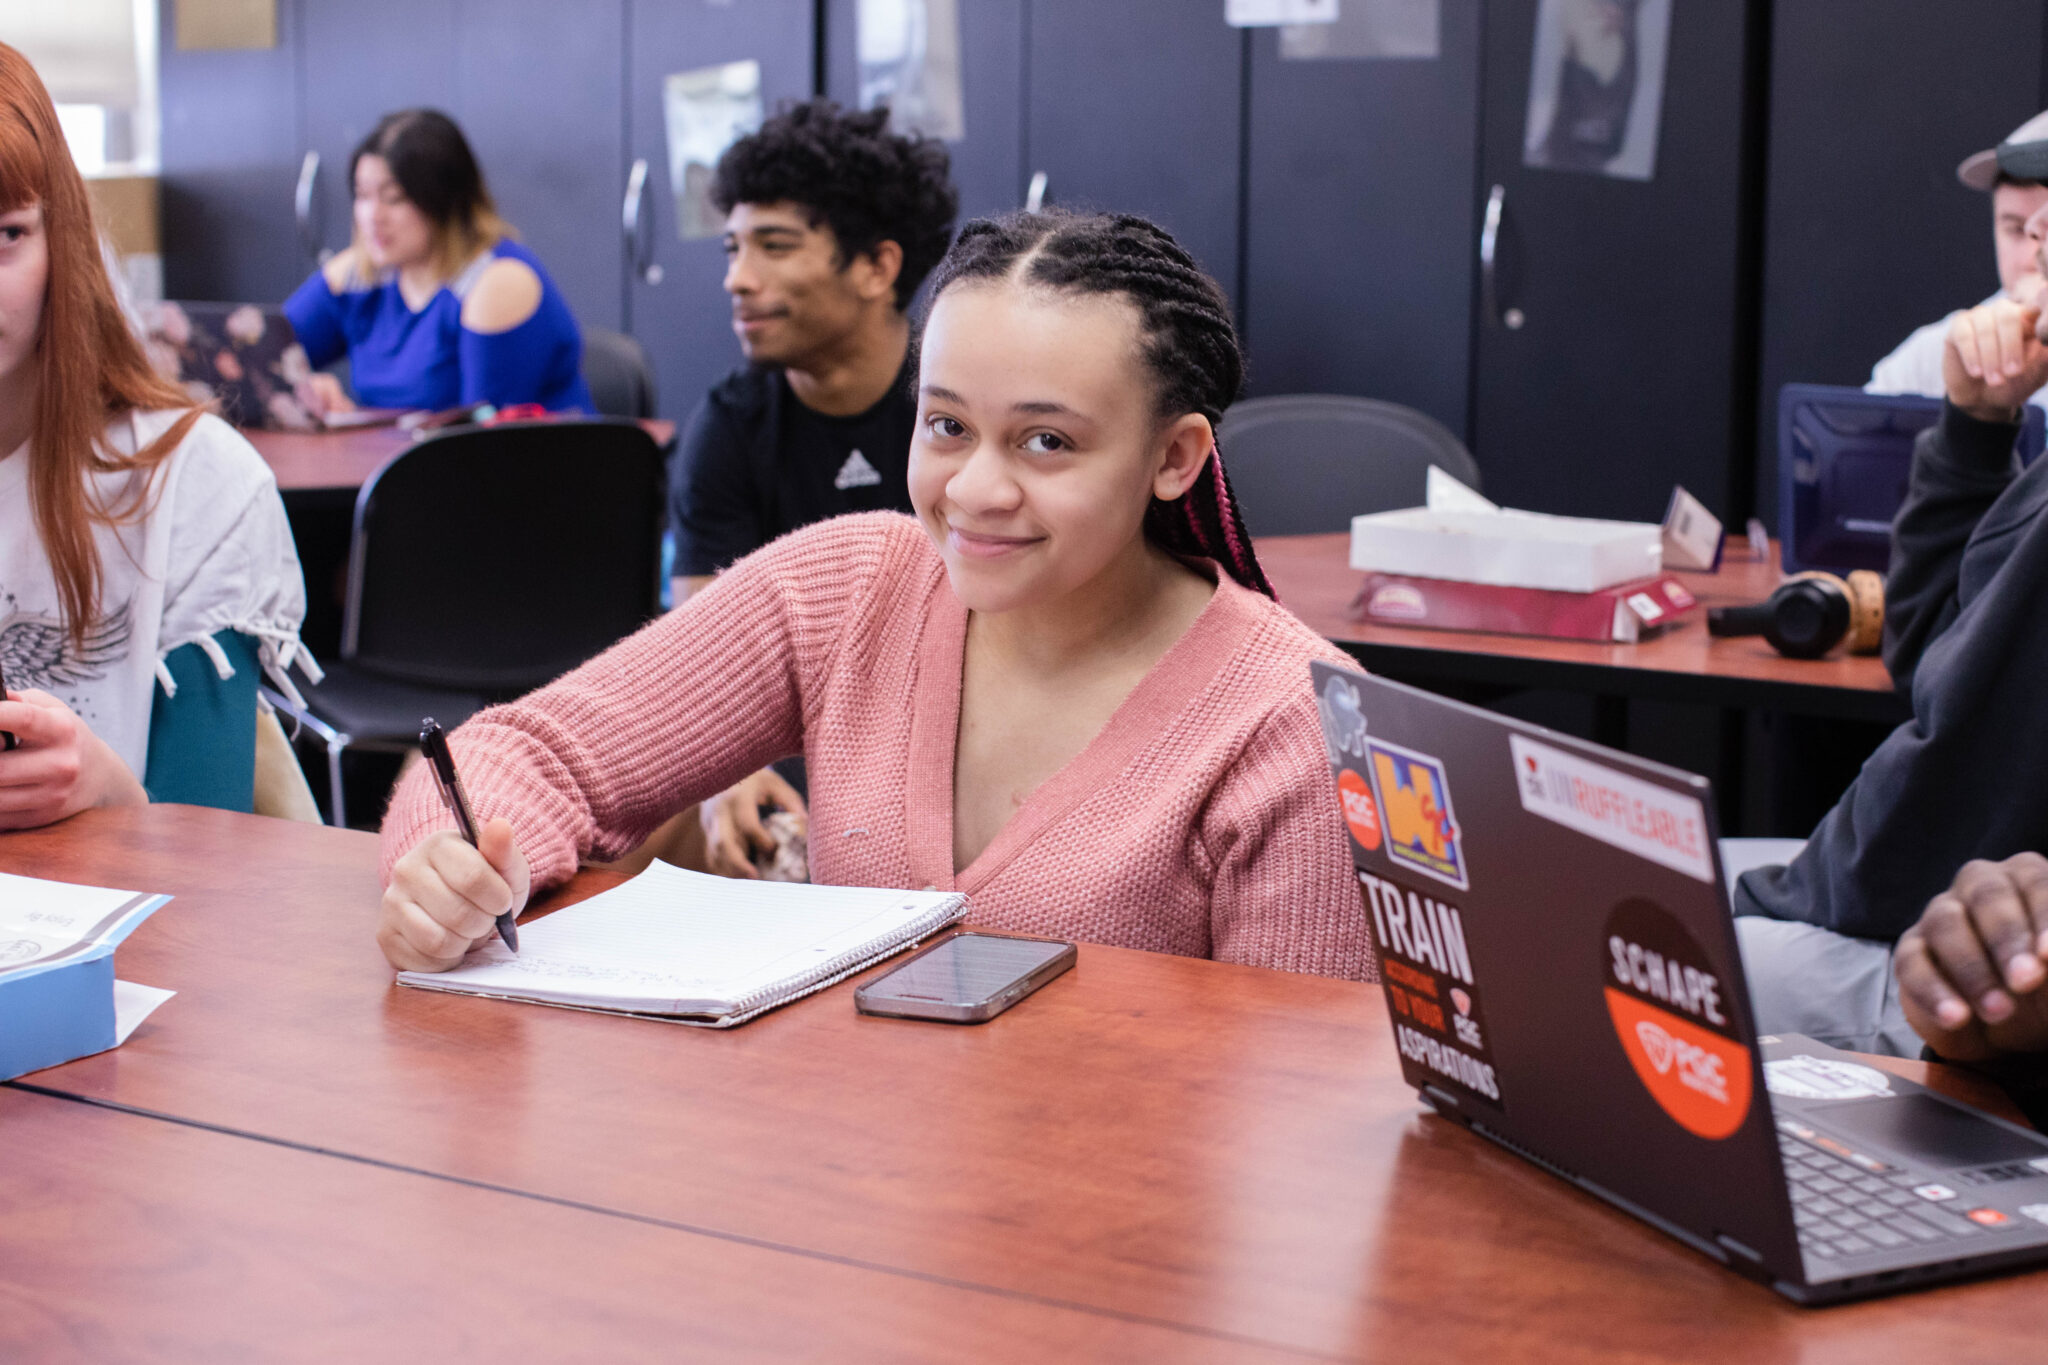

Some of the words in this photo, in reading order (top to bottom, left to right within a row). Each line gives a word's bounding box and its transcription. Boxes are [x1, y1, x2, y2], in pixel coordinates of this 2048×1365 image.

[1546, 766, 1701, 859] UNRUFFLEABLE
[1359, 871, 1474, 985] TRAIN
[1397, 1023, 1500, 1100] ASPIRATIONS
